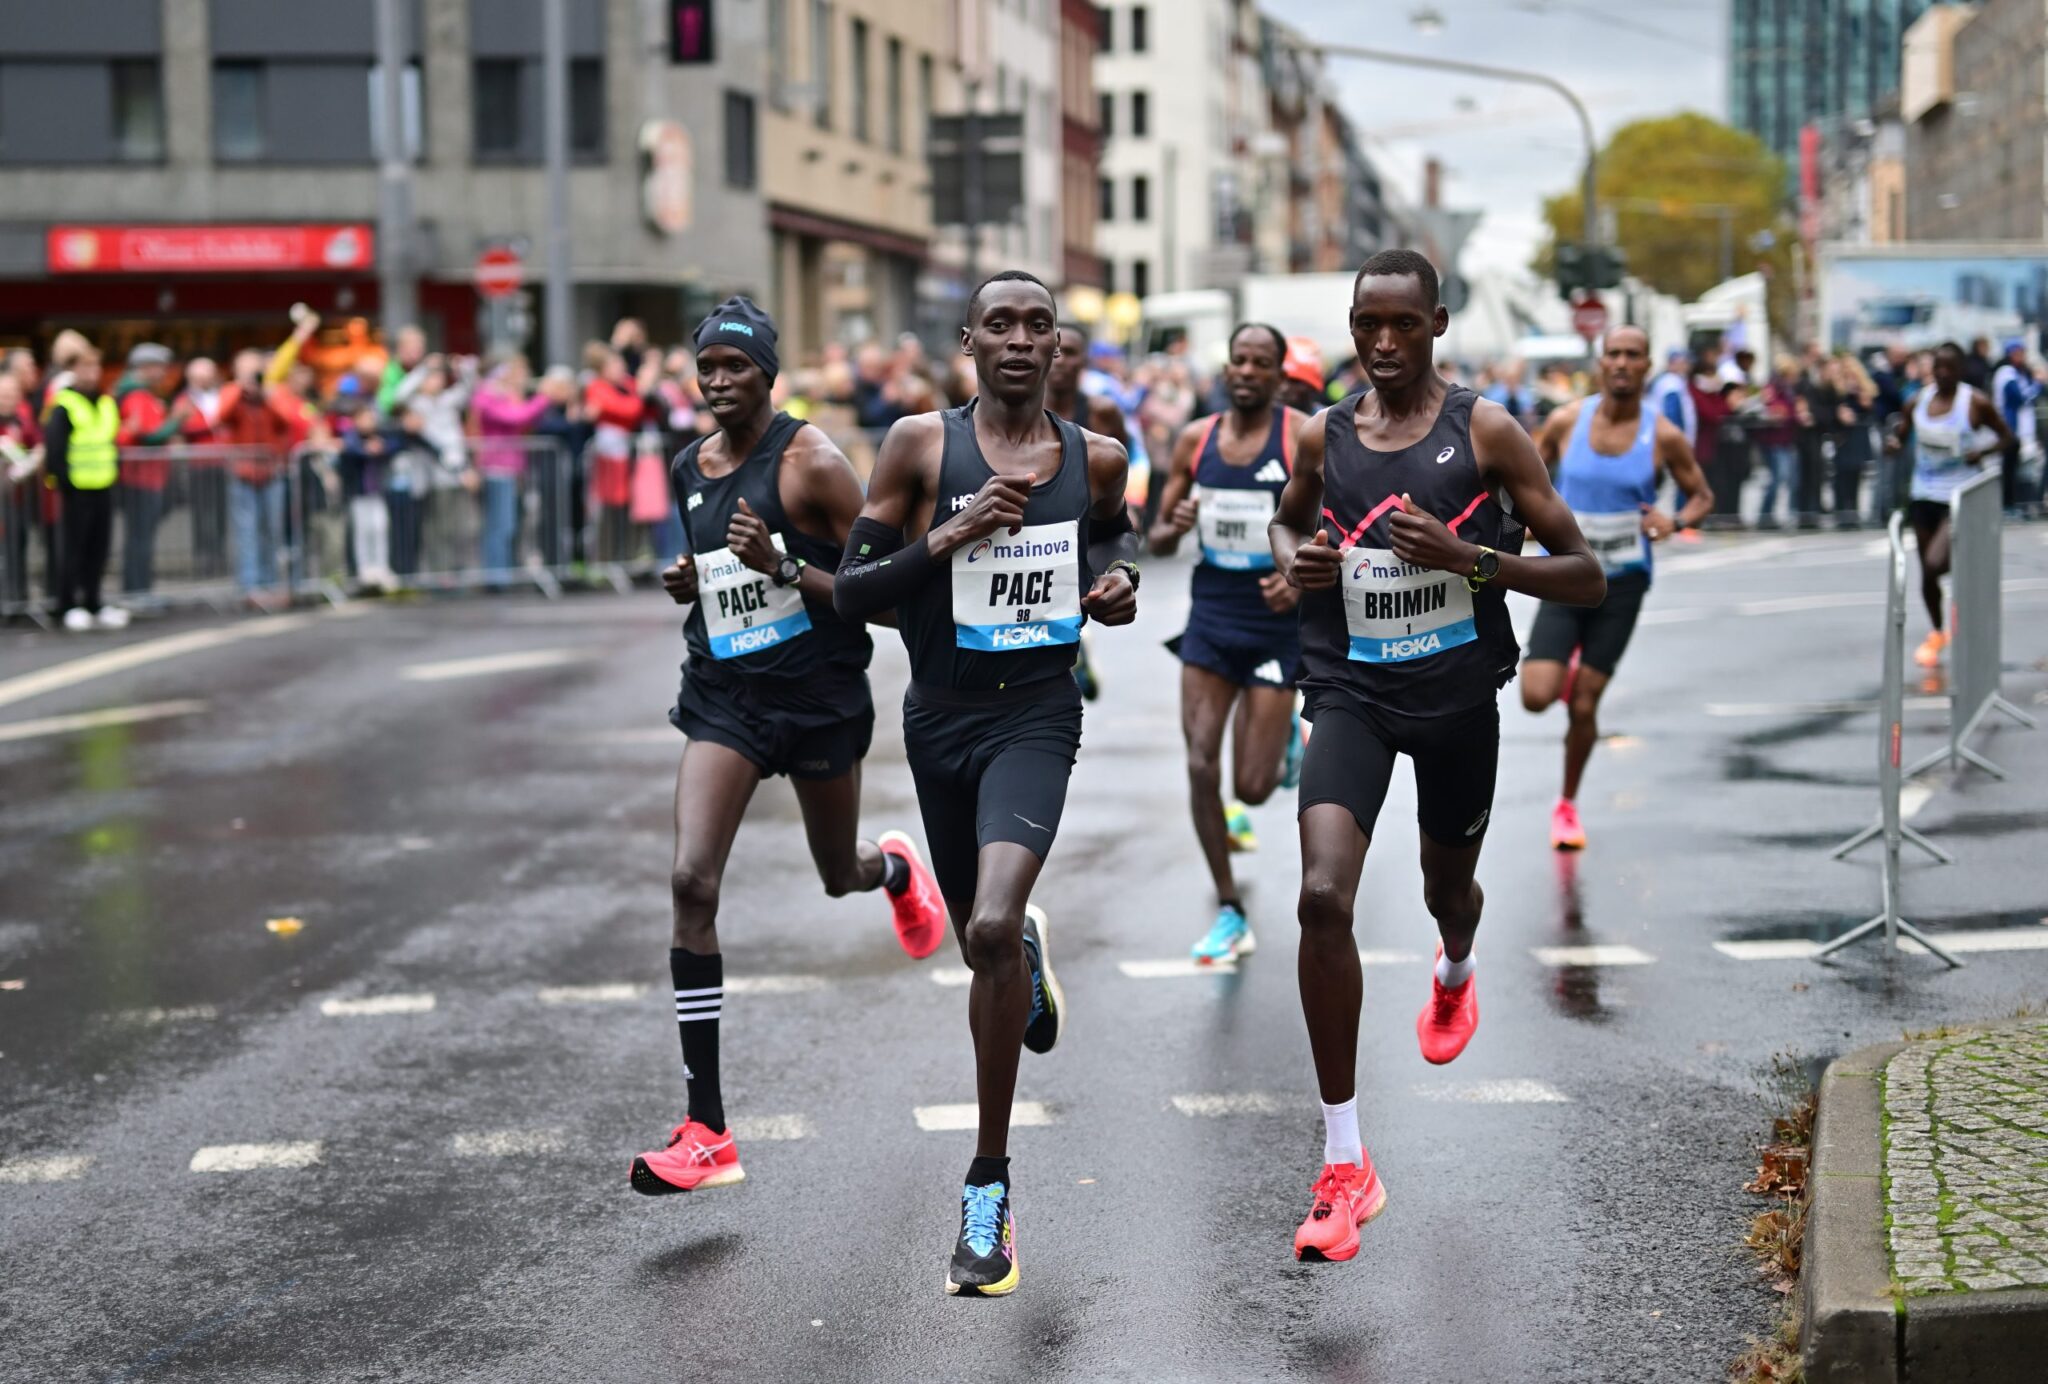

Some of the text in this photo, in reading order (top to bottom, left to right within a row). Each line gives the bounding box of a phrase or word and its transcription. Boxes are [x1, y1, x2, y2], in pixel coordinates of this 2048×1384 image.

[719, 321, 753, 337] HOKA
[951, 493, 978, 511] HO
[993, 538, 1070, 559] mainova
[712, 559, 748, 579] main
[1372, 561, 1432, 579] maino
[989, 569, 1055, 607] PACE
[717, 579, 769, 619] PACE
[1364, 582, 1447, 620] BRIMIN
[742, 615, 753, 629] 97
[1016, 608, 1031, 623] 98
[992, 623, 1051, 648] HOKA
[1405, 622, 1412, 635] 1
[729, 625, 781, 654] HOKA
[1381, 632, 1442, 660] HOKA
